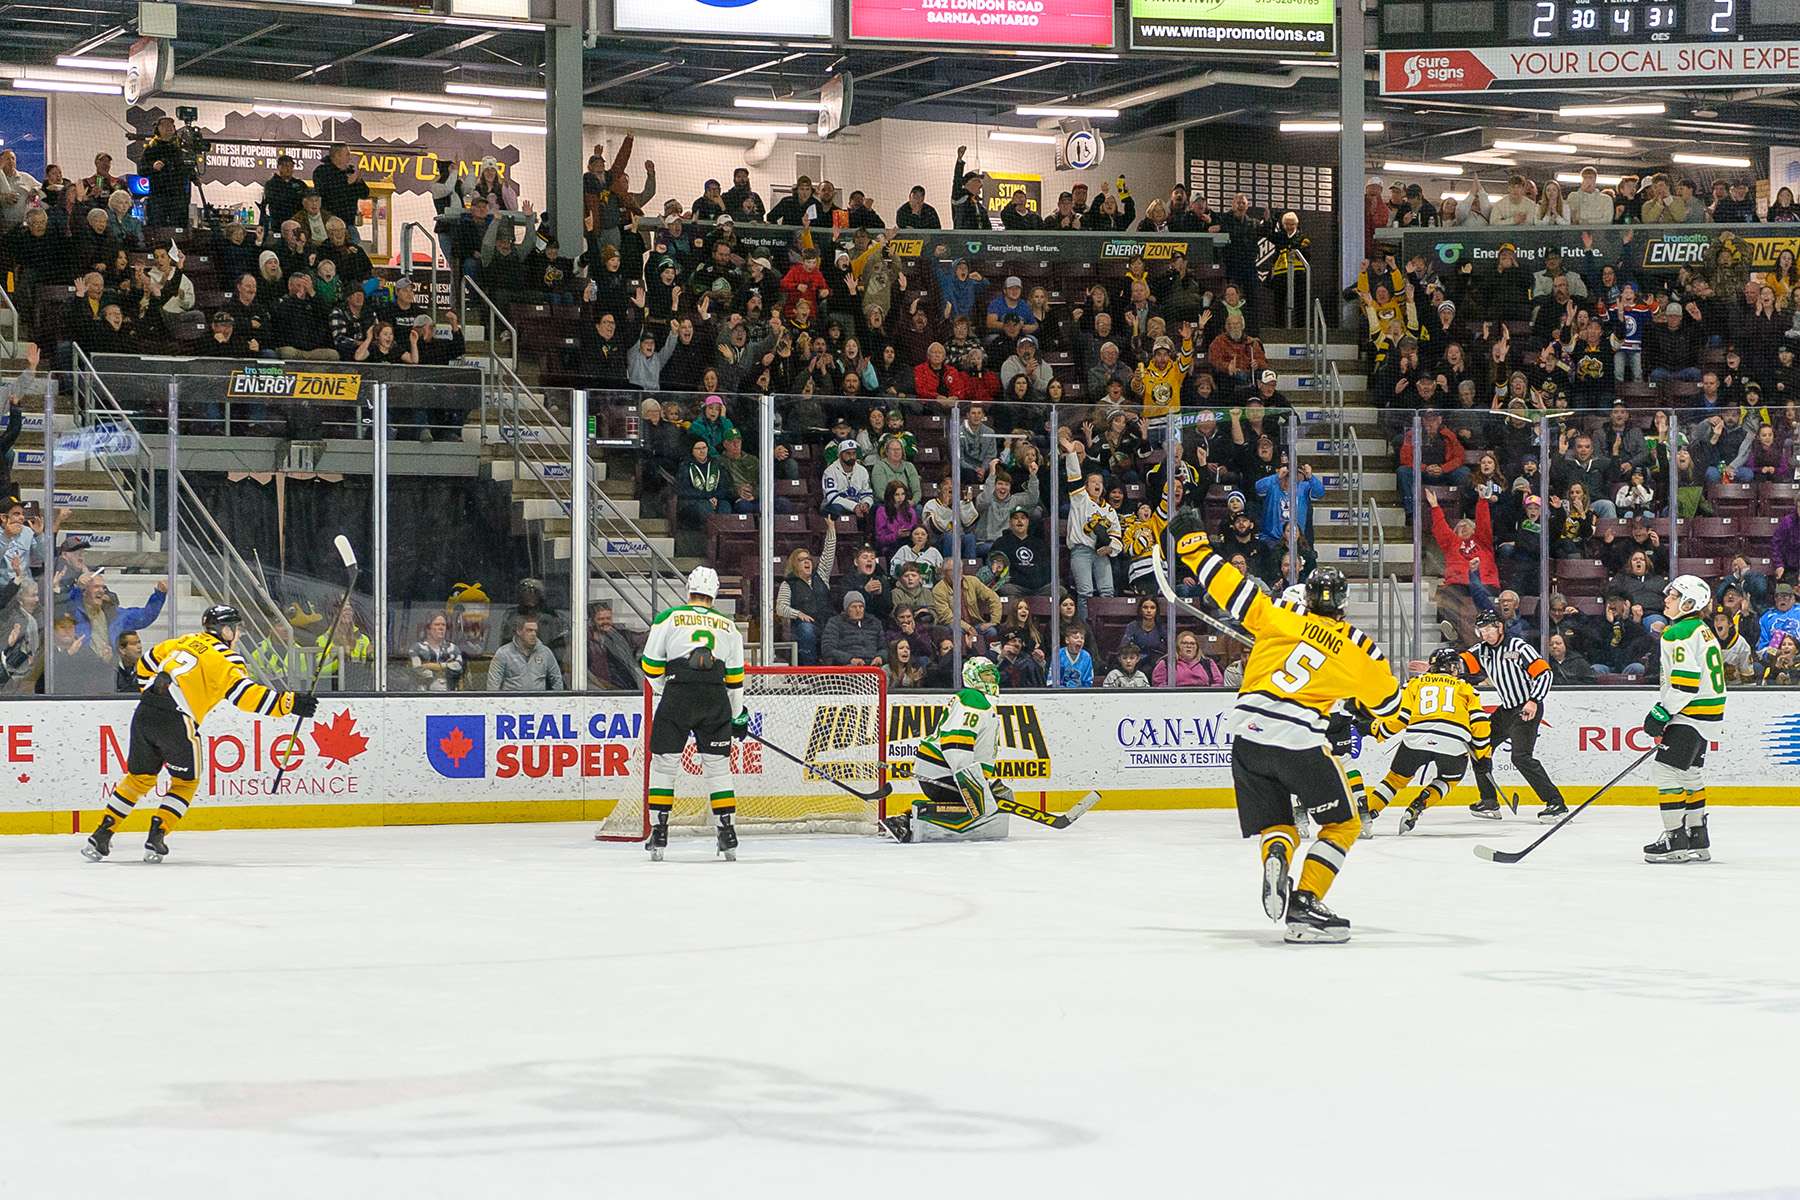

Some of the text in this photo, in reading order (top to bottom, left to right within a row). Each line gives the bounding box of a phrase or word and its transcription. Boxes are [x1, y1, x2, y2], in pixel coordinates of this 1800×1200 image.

[951, 0, 1004, 11] LONDON
[1007, 0, 1044, 12] ROAD
[1533, 0, 1733, 37] 2 30 4 31 2
[1140, 24, 1325, 42] www.wmapromotions.ca
[1418, 57, 1450, 69] sure
[1510, 52, 1579, 75] YOUR
[1588, 50, 1668, 74] LOCAL
[1677, 49, 1733, 72] SIGN
[1427, 67, 1464, 81] signs
[215, 143, 322, 160] FRESH POPCORN HOT NUTS
[206, 155, 229, 167] SNOW
[230, 156, 256, 169] CONES
[987, 244, 1022, 253] Energizing
[1023, 244, 1035, 252] the
[1105, 244, 1145, 257] ENERGY
[234, 375, 348, 396] ENERGY ZONE
[1322, 590, 1330, 600] 5
[1300, 622, 1344, 655] YOUNG
[1271, 640, 1328, 694] 5
[1419, 684, 1456, 715] 81
[496, 713, 579, 740] REAL
[1130, 753, 1233, 765] TRAINING & TESTING
[221, 776, 359, 797] INSURANCE
[997, 799, 1057, 825] CCM
[1308, 799, 1340, 815] CCM
